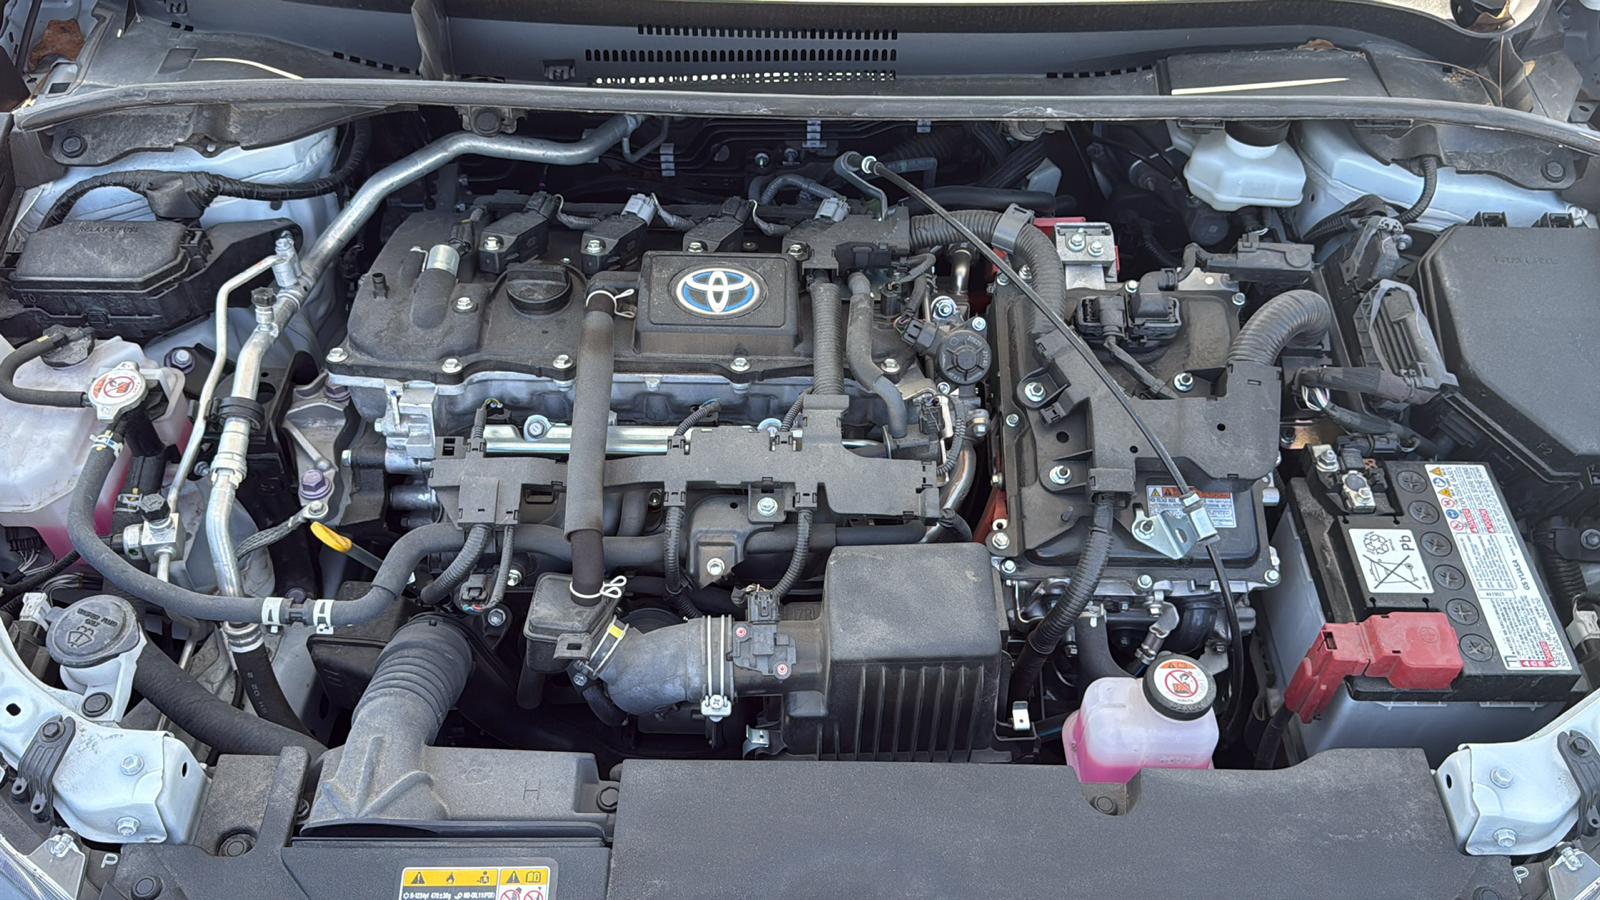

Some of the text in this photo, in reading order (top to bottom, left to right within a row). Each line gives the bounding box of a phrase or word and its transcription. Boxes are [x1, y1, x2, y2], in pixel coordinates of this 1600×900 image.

[1400, 534, 1415, 552] Pb
[1510, 559, 1527, 580] YUASA
[1520, 581, 1530, 590] GS
[77, 608, 118, 627] WASHER FLUID
[85, 618, 101, 627] ONLY
[522, 780, 542, 800] H
